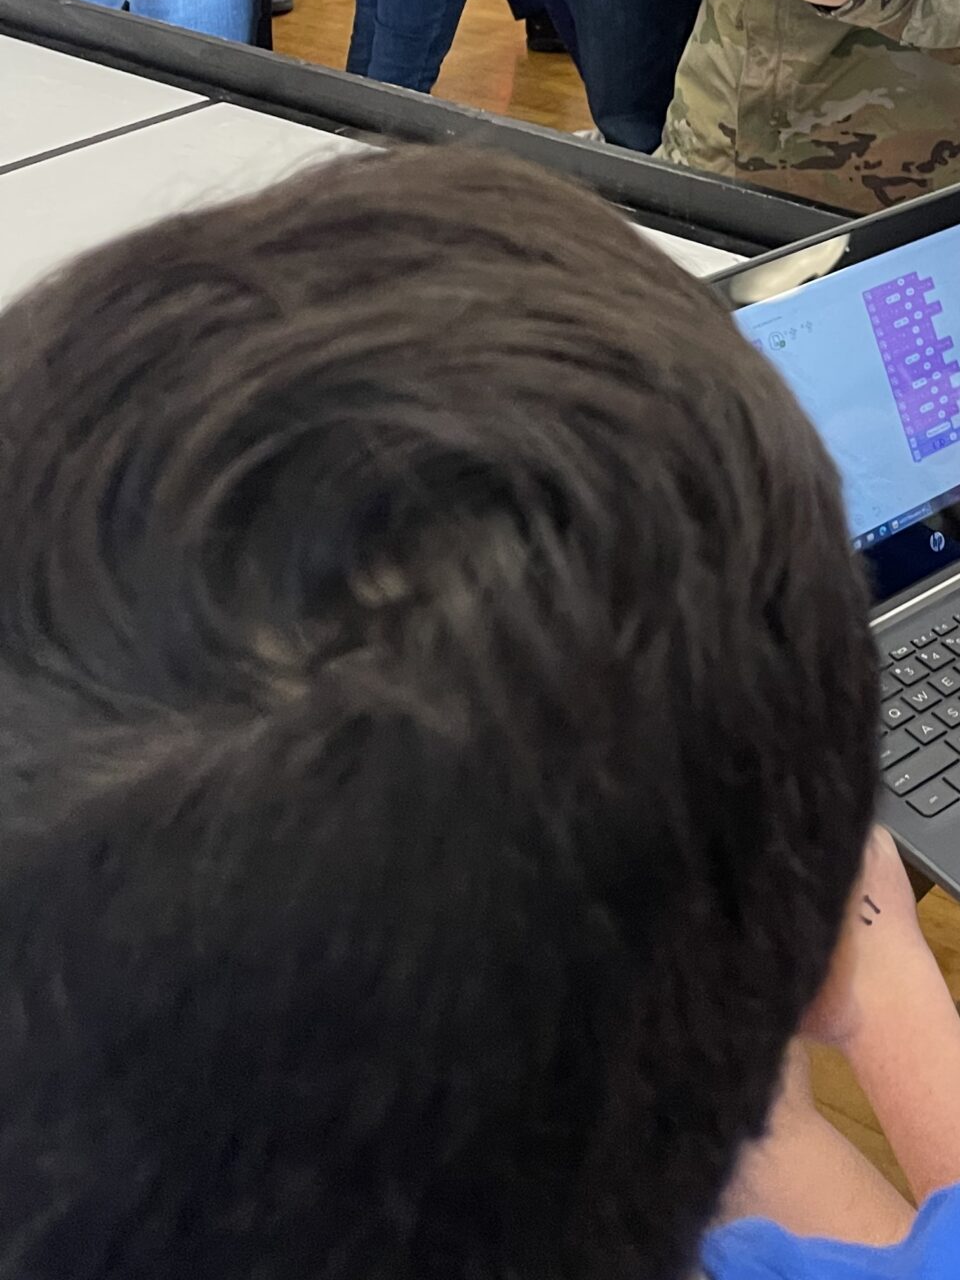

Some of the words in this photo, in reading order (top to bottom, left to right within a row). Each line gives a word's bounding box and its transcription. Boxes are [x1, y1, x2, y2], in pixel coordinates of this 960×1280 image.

[912, 690, 928, 703] W
[941, 677, 954, 687] E
[921, 725, 934, 734] A
[947, 709, 959, 718] S
